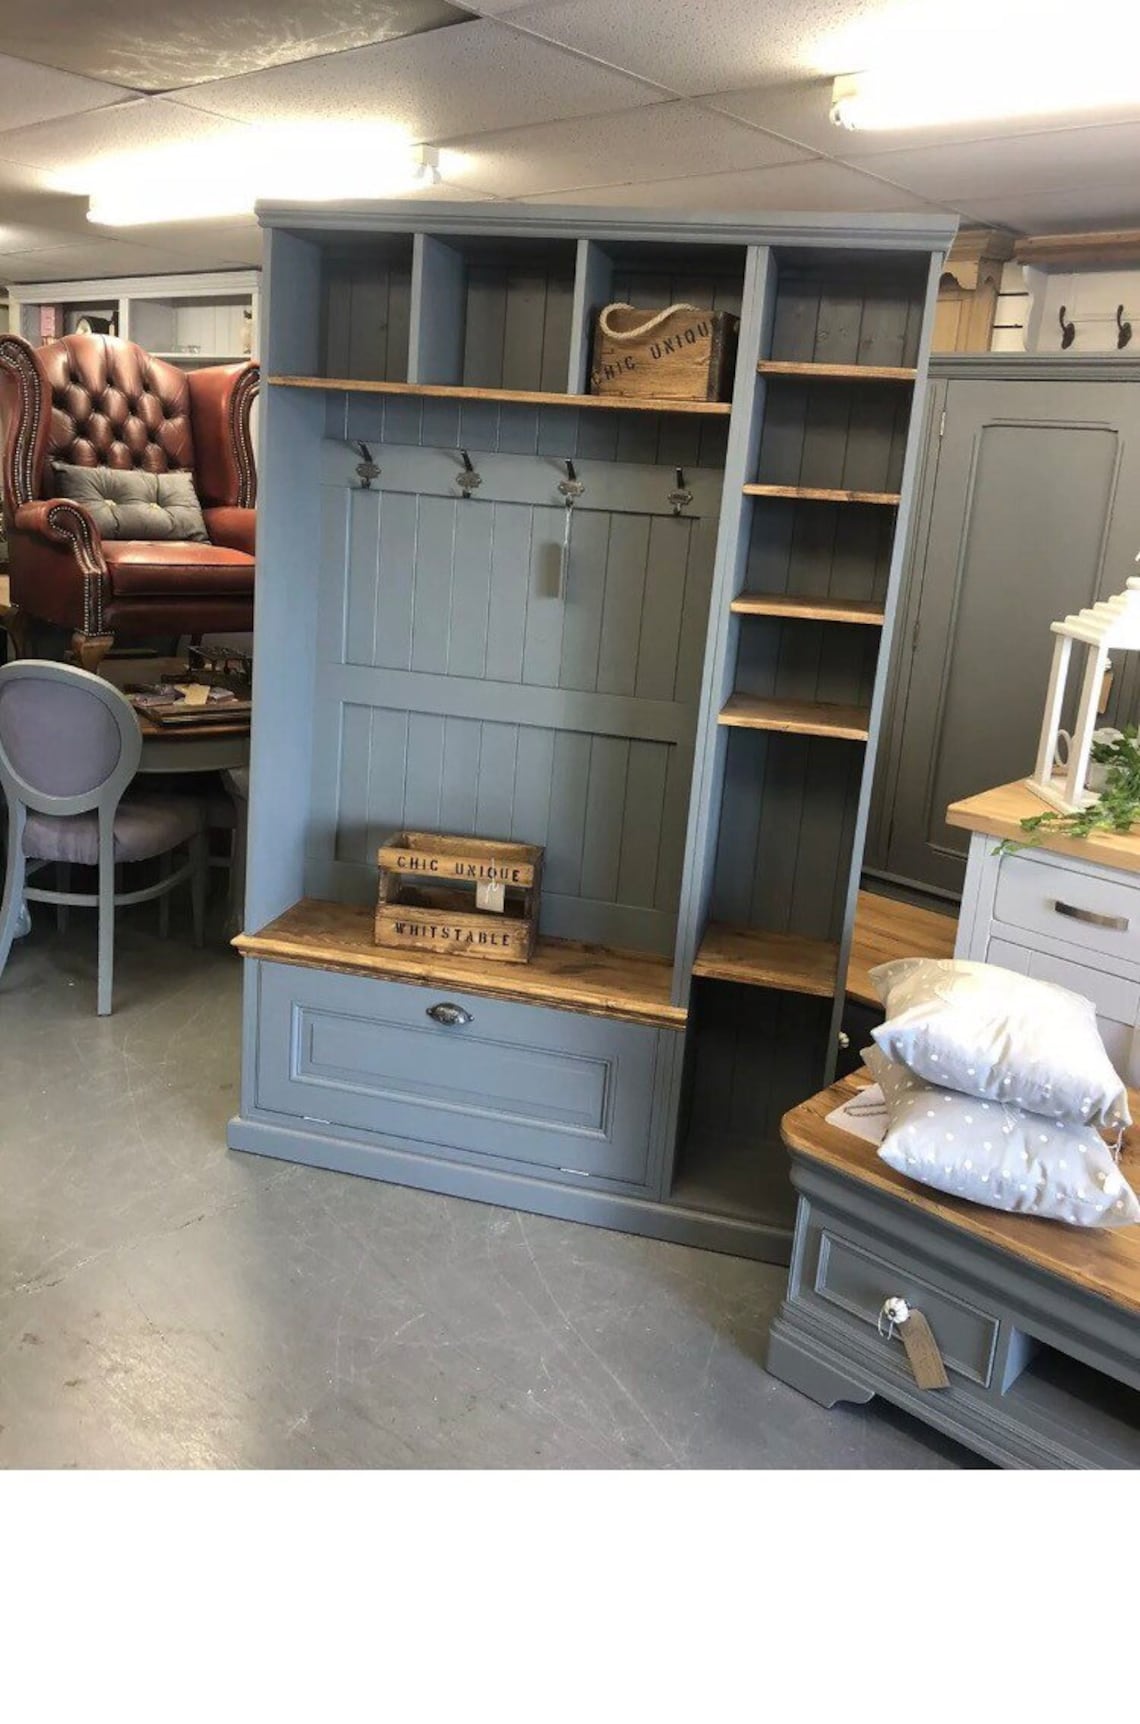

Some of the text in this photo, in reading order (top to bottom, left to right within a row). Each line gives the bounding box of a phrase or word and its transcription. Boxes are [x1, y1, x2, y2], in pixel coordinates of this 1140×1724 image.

[591, 356, 635, 385] CHIC
[397, 856, 520, 882] CHIC UNIQUE
[395, 922, 510, 946] WHITSTABLE
